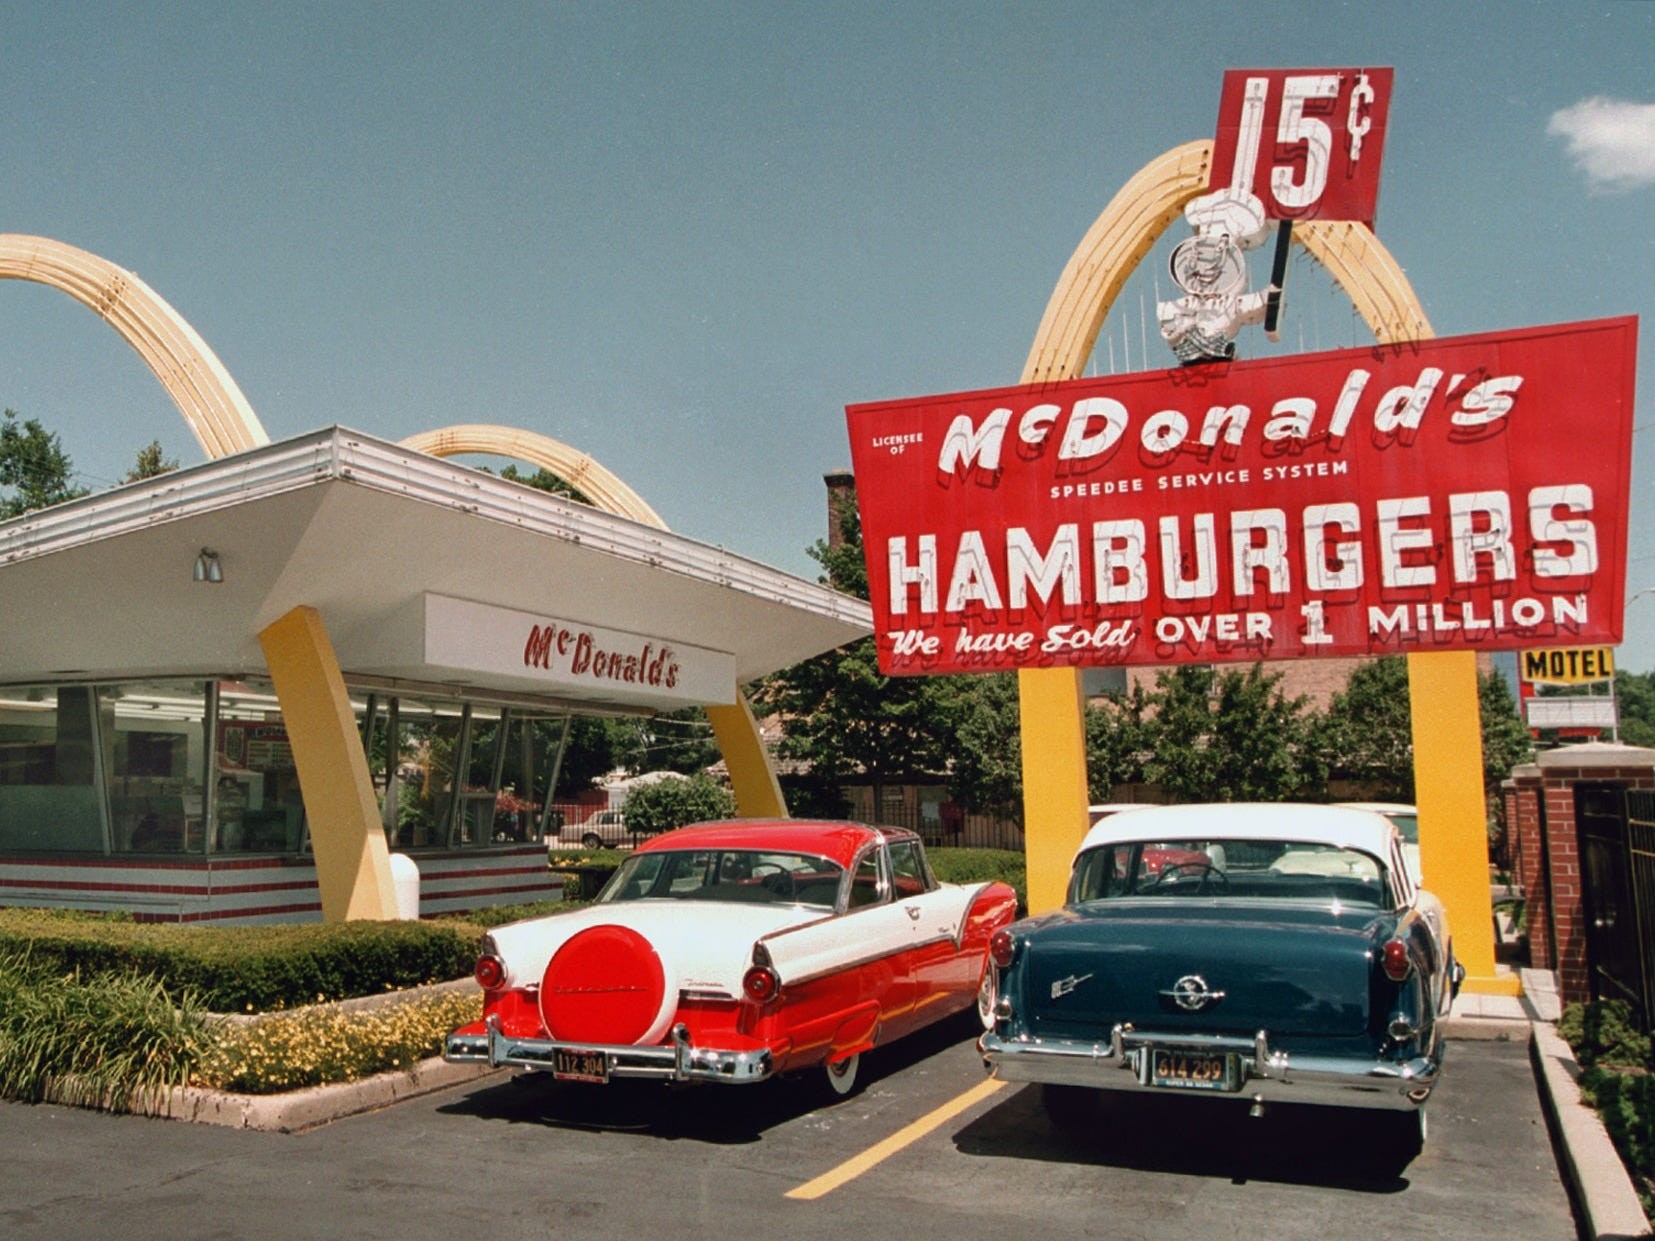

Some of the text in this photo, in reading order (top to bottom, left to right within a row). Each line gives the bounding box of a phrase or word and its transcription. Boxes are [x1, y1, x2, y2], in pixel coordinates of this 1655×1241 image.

[937, 367, 1525, 475] McDonald's
[872, 433, 923, 448] LICENSEE
[890, 445, 905, 455] OF
[1050, 461, 1348, 498] SPEEDEE SERVICE SYSTEM
[888, 484, 1599, 615] HAMBURGERS
[887, 629, 940, 656] We
[955, 627, 1034, 653] have
[1155, 612, 1274, 643] OVER
[1301, 600, 1334, 644] 1
[1368, 594, 1589, 635] MILLION
[1525, 649, 1611, 678] MOTEL
